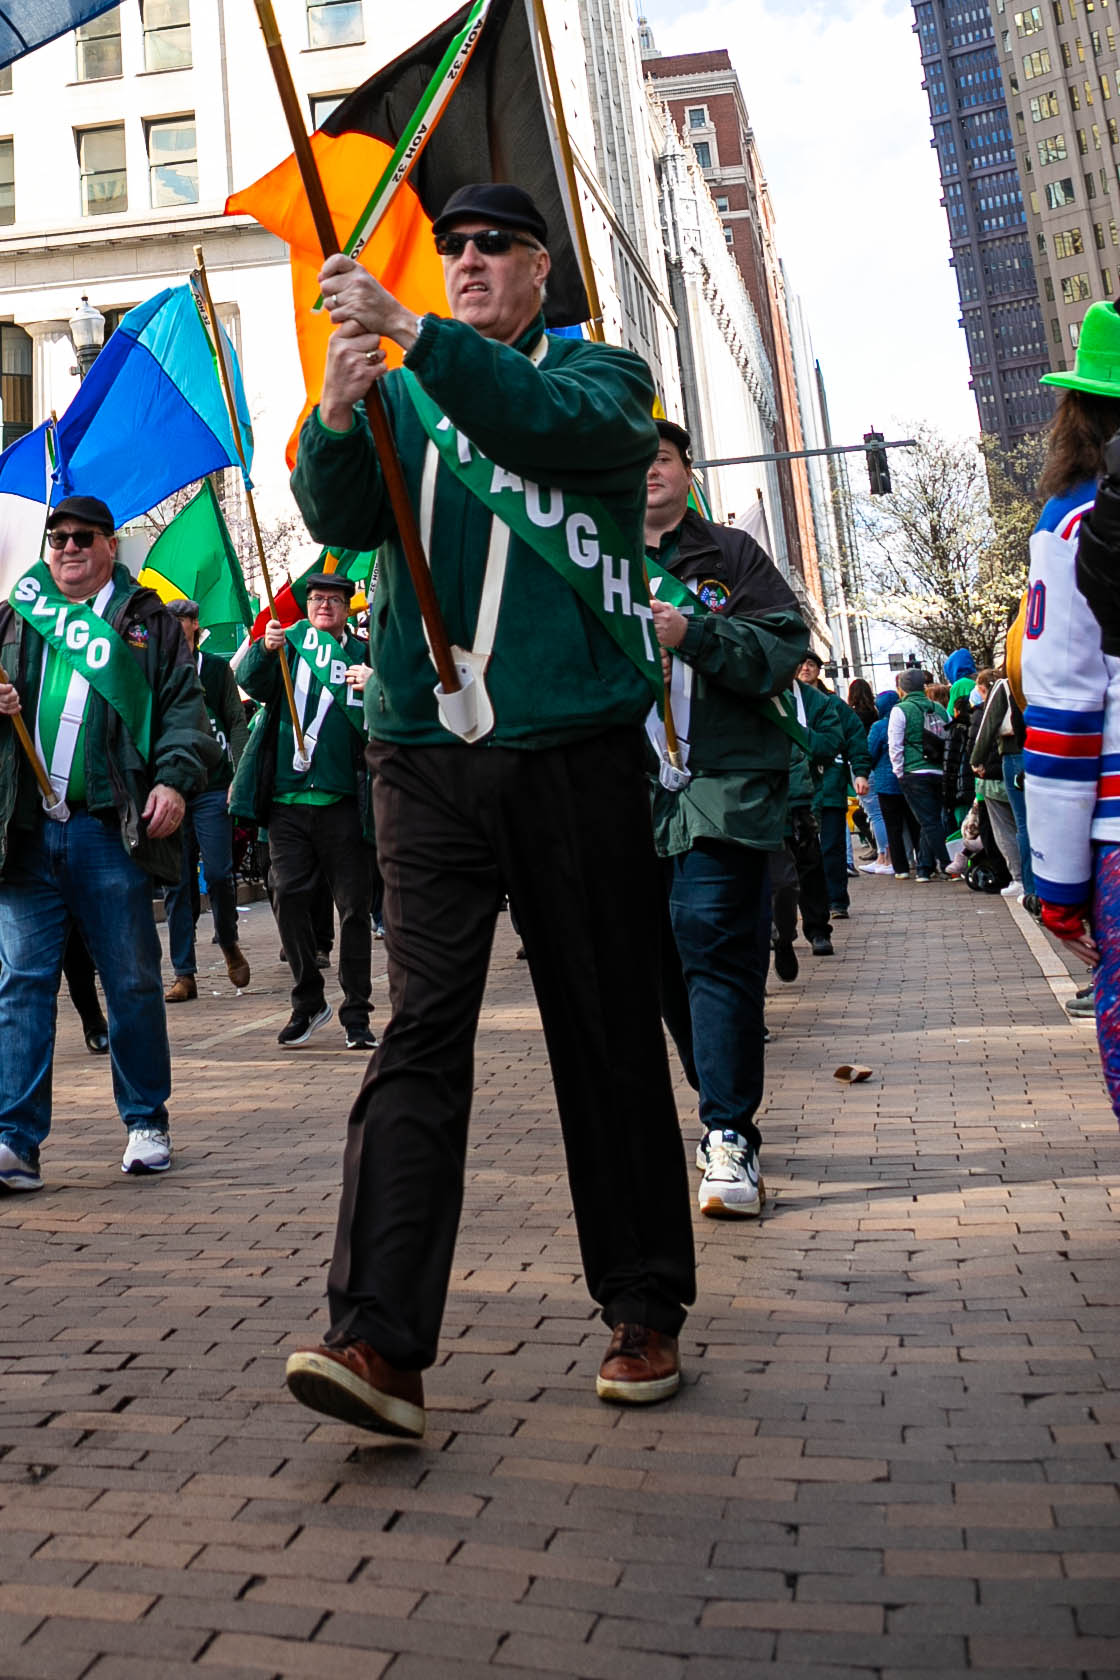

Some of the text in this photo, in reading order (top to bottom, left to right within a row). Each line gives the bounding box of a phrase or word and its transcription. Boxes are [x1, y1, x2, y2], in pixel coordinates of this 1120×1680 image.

[447, 18, 483, 79] AOH 32
[392, 123, 428, 182] AOH 32
[351, 237, 365, 260] AO
[14, 576, 111, 670] SLIGO
[302, 627, 367, 729] DUBL
